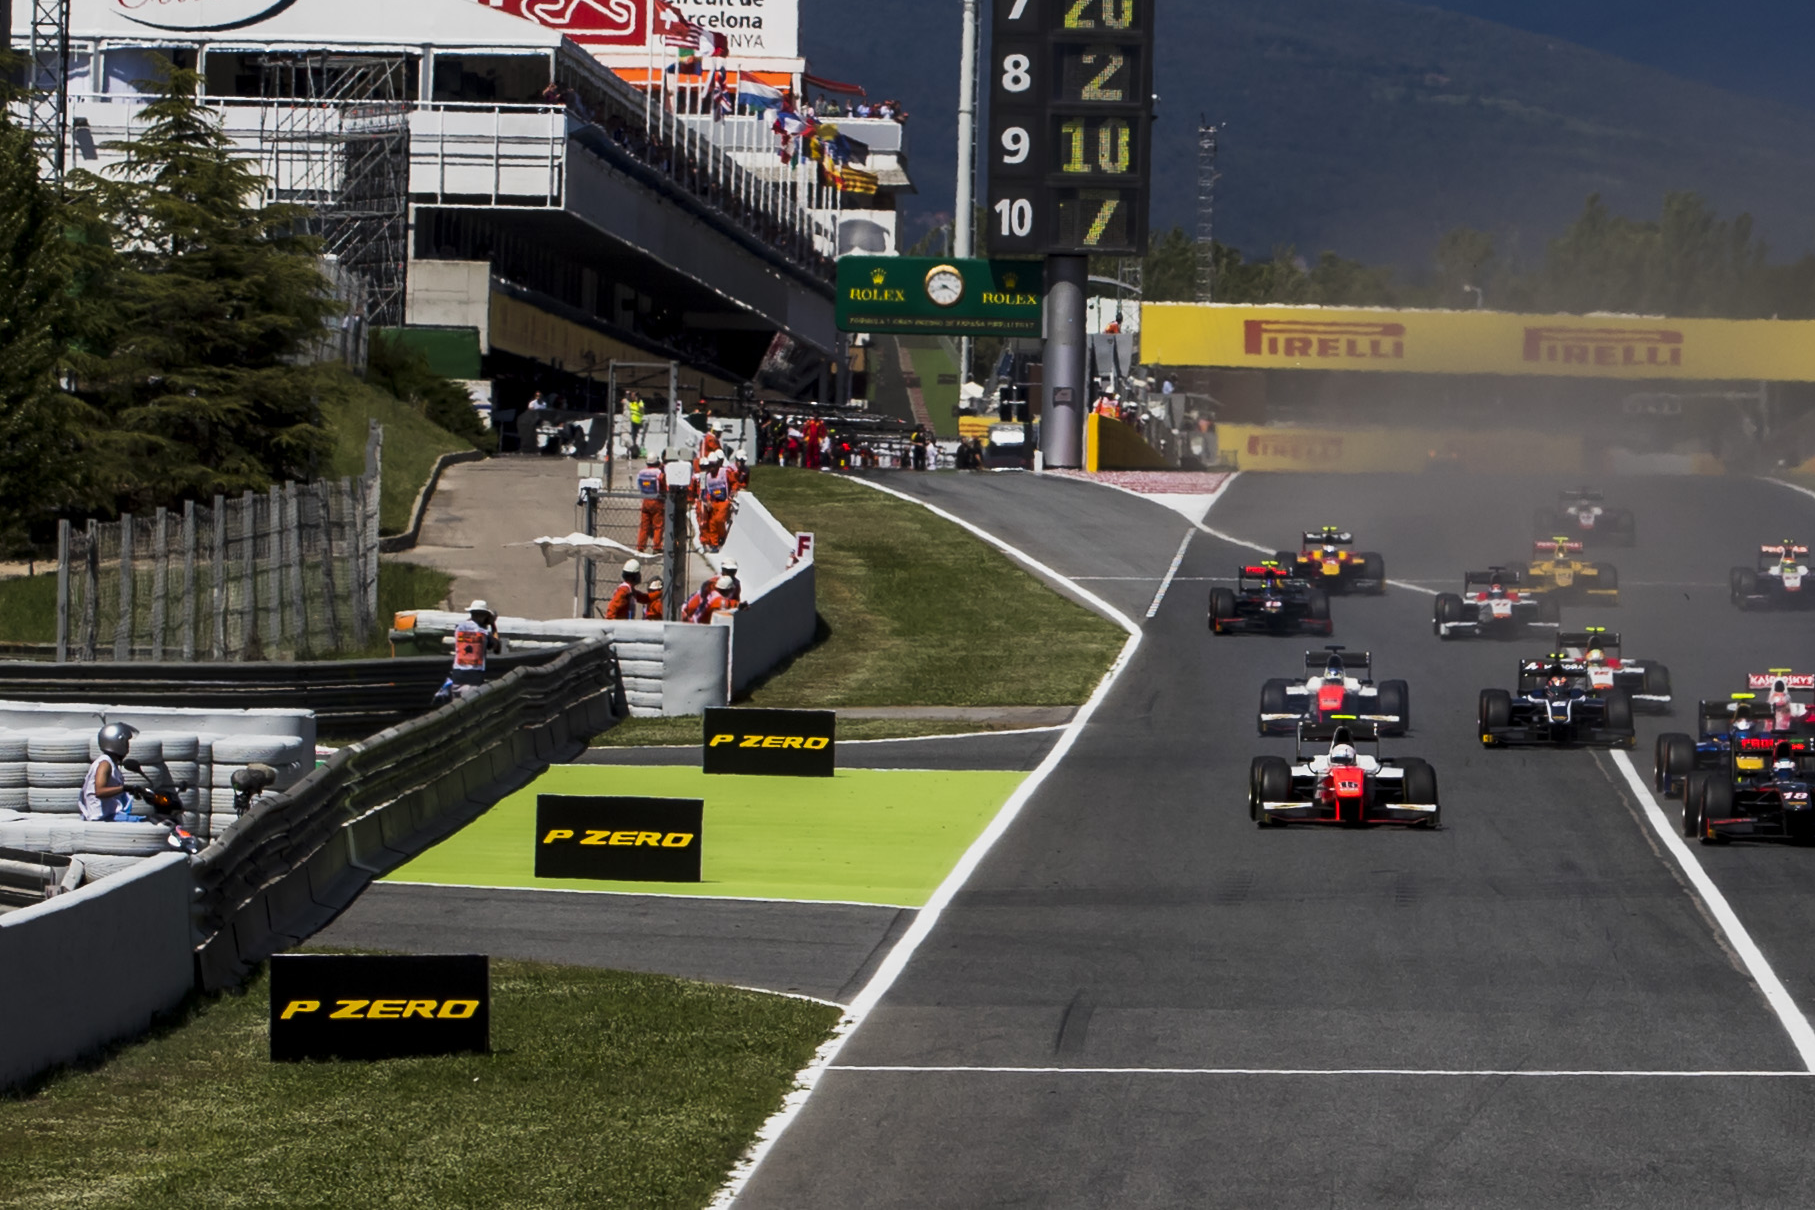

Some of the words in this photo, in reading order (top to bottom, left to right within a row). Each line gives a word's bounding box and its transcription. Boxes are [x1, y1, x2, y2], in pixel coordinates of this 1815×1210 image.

[688, 10, 763, 30] rcelona
[1002, 53, 1031, 92] 8
[1001, 126, 1030, 164] 9
[994, 198, 1033, 237] 10
[850, 288, 906, 302] ROLEX
[982, 292, 1038, 306] ROLEX
[1244, 319, 1407, 359] PIRELLI
[1522, 326, 1684, 367] PIRELLI
[797, 535, 812, 557] F
[709, 734, 735, 747] P
[738, 734, 830, 750] ZERO
[543, 829, 575, 844] P
[579, 829, 694, 848] ZERO
[280, 1000, 321, 1020] P
[329, 999, 480, 1020] ZERO
